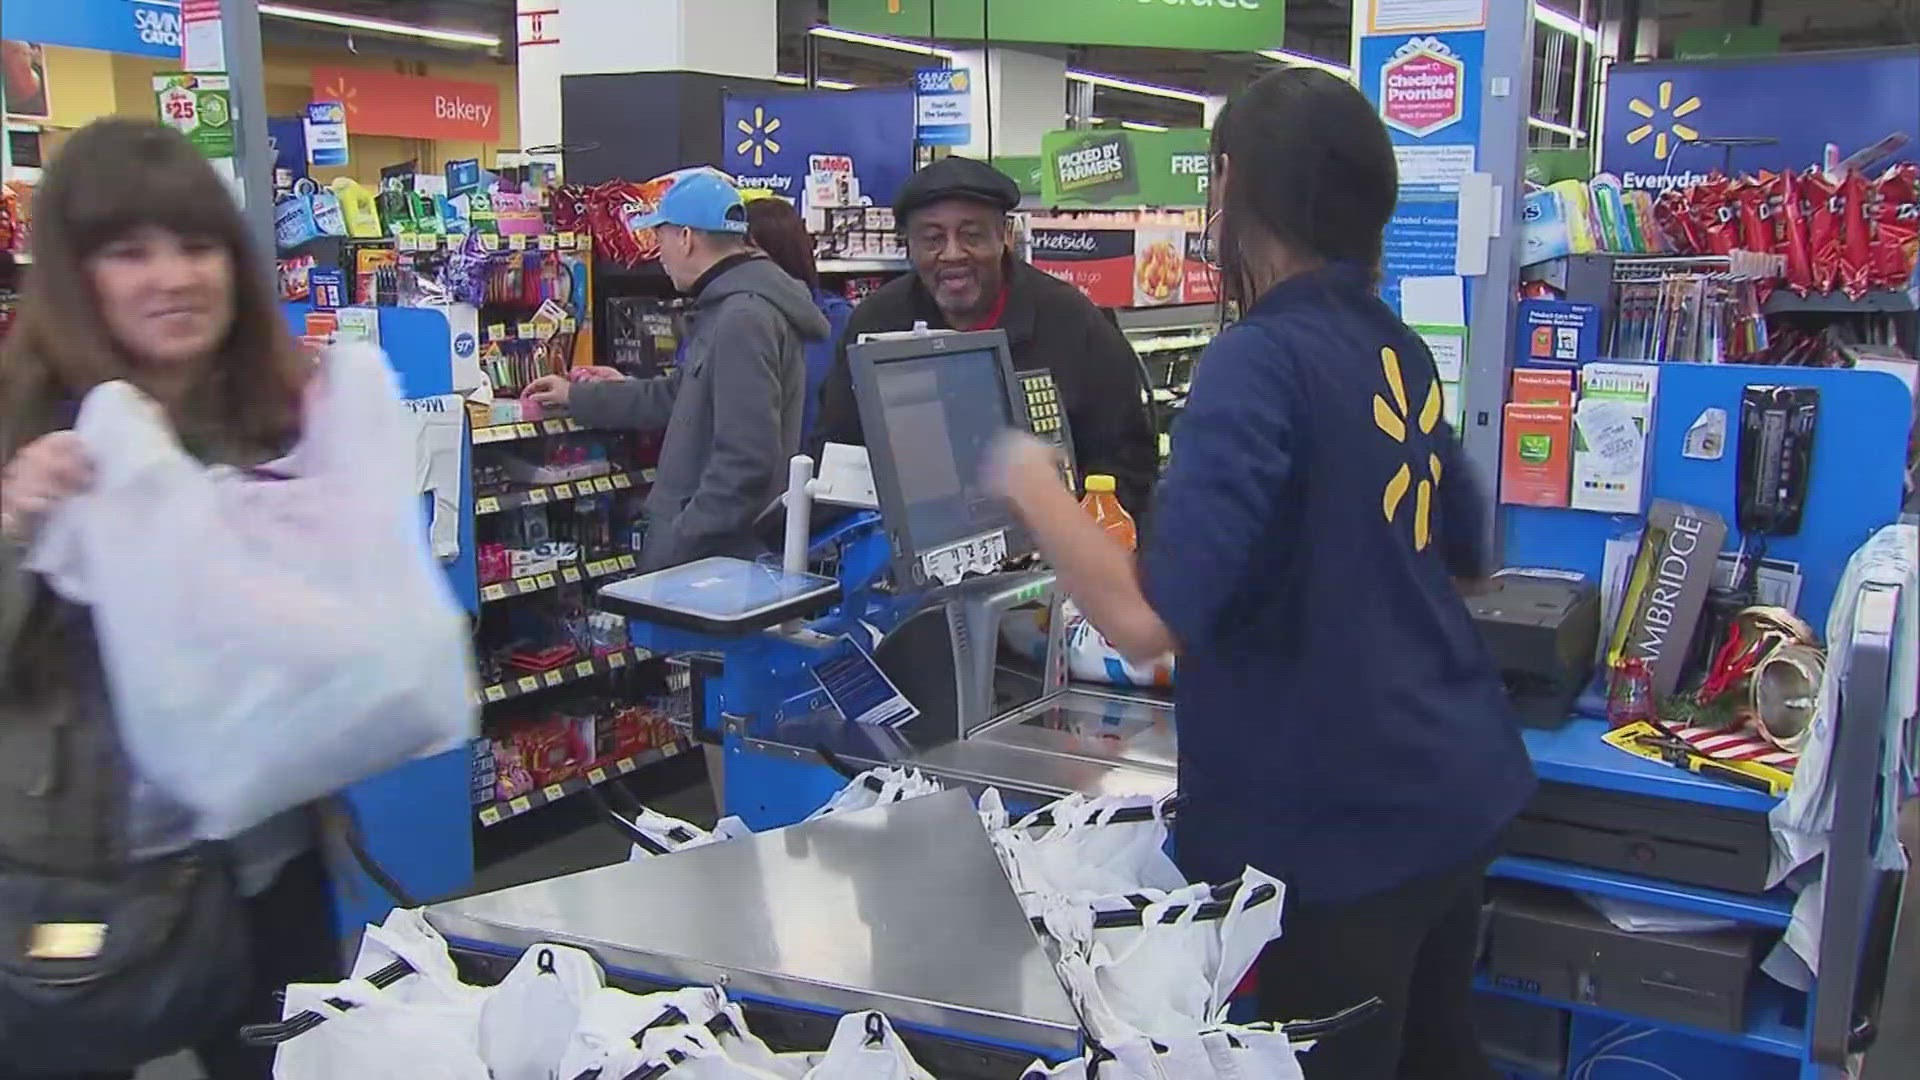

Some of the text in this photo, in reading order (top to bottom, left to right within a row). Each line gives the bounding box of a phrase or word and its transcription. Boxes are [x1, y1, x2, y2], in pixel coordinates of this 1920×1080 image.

[1388, 72, 1455, 87] Checkout
[1388, 86, 1455, 102] Promise
[165, 102, 194, 119] $25
[435, 95, 492, 127] Bakery
[1058, 142, 1119, 169] PICKED BY
[812, 157, 850, 172] nutella
[1060, 156, 1122, 182] FARMERS
[737, 174, 792, 190] Everyday
